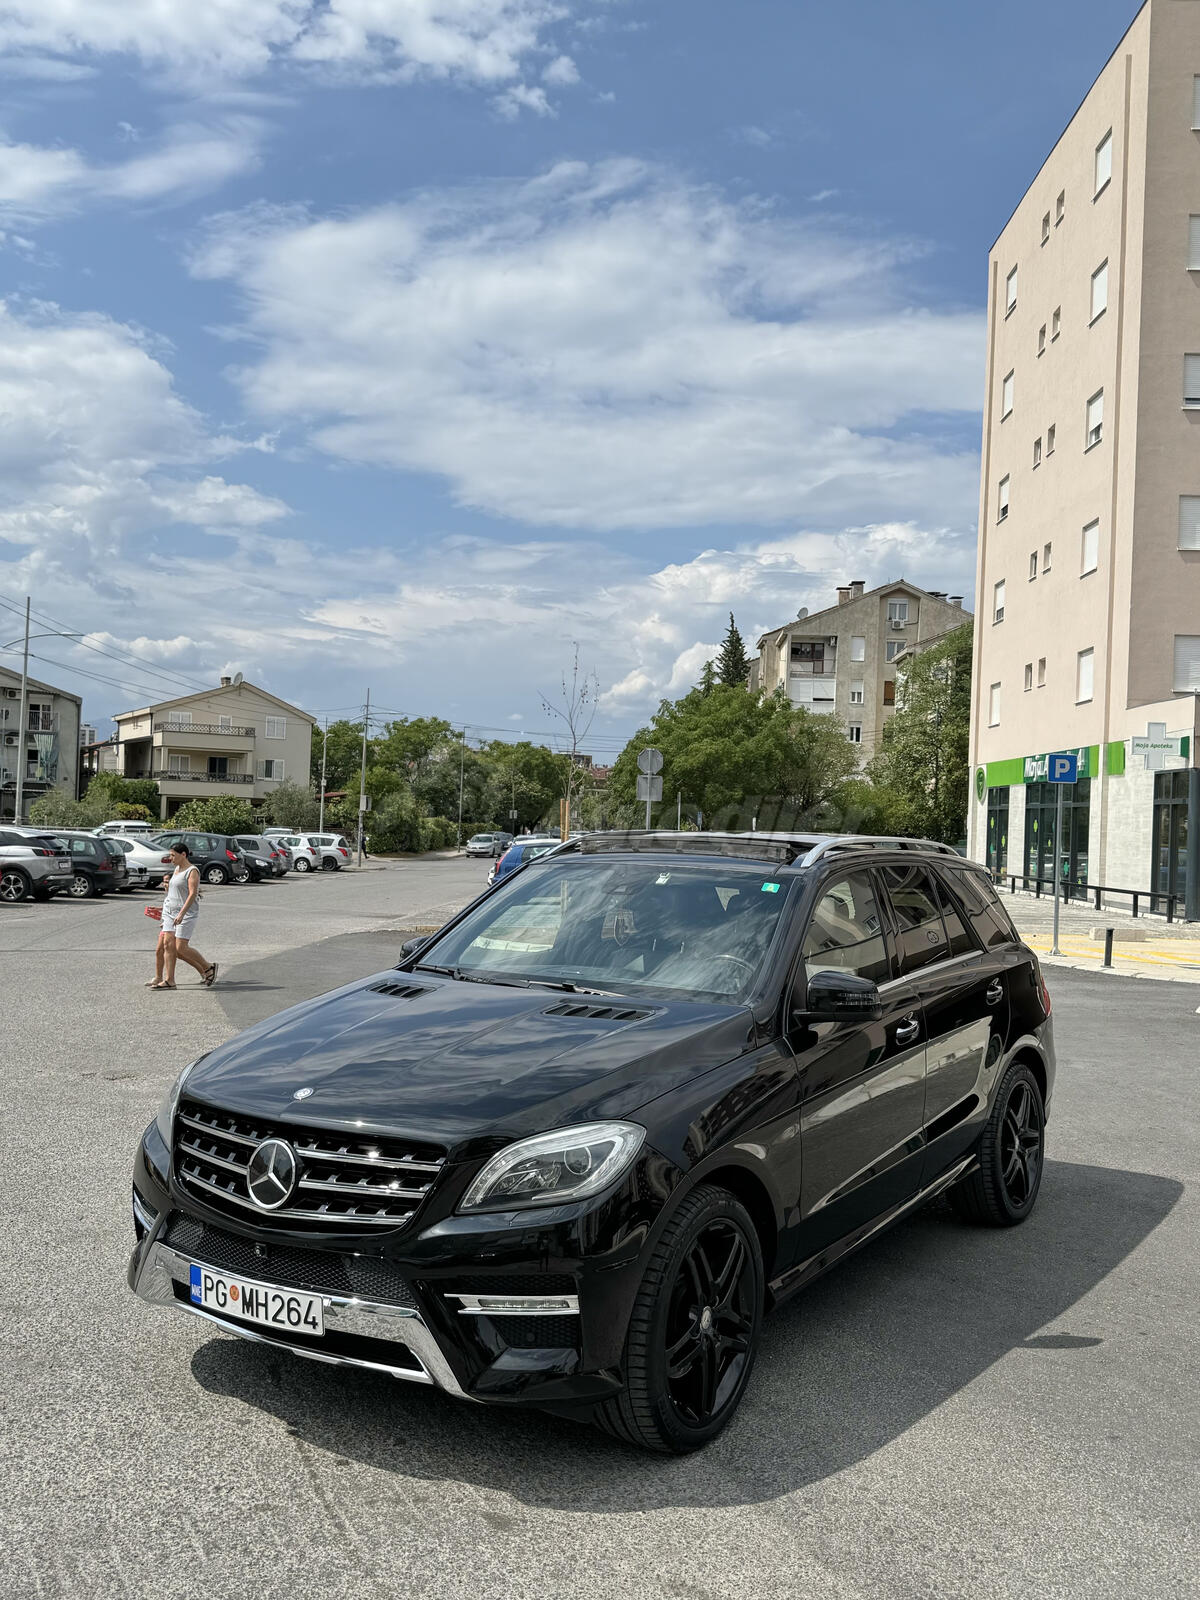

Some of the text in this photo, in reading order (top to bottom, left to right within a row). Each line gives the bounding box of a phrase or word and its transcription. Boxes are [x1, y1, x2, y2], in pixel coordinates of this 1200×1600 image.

[1055, 759, 1070, 778] P
[204, 1274, 318, 1330] PG MH264
